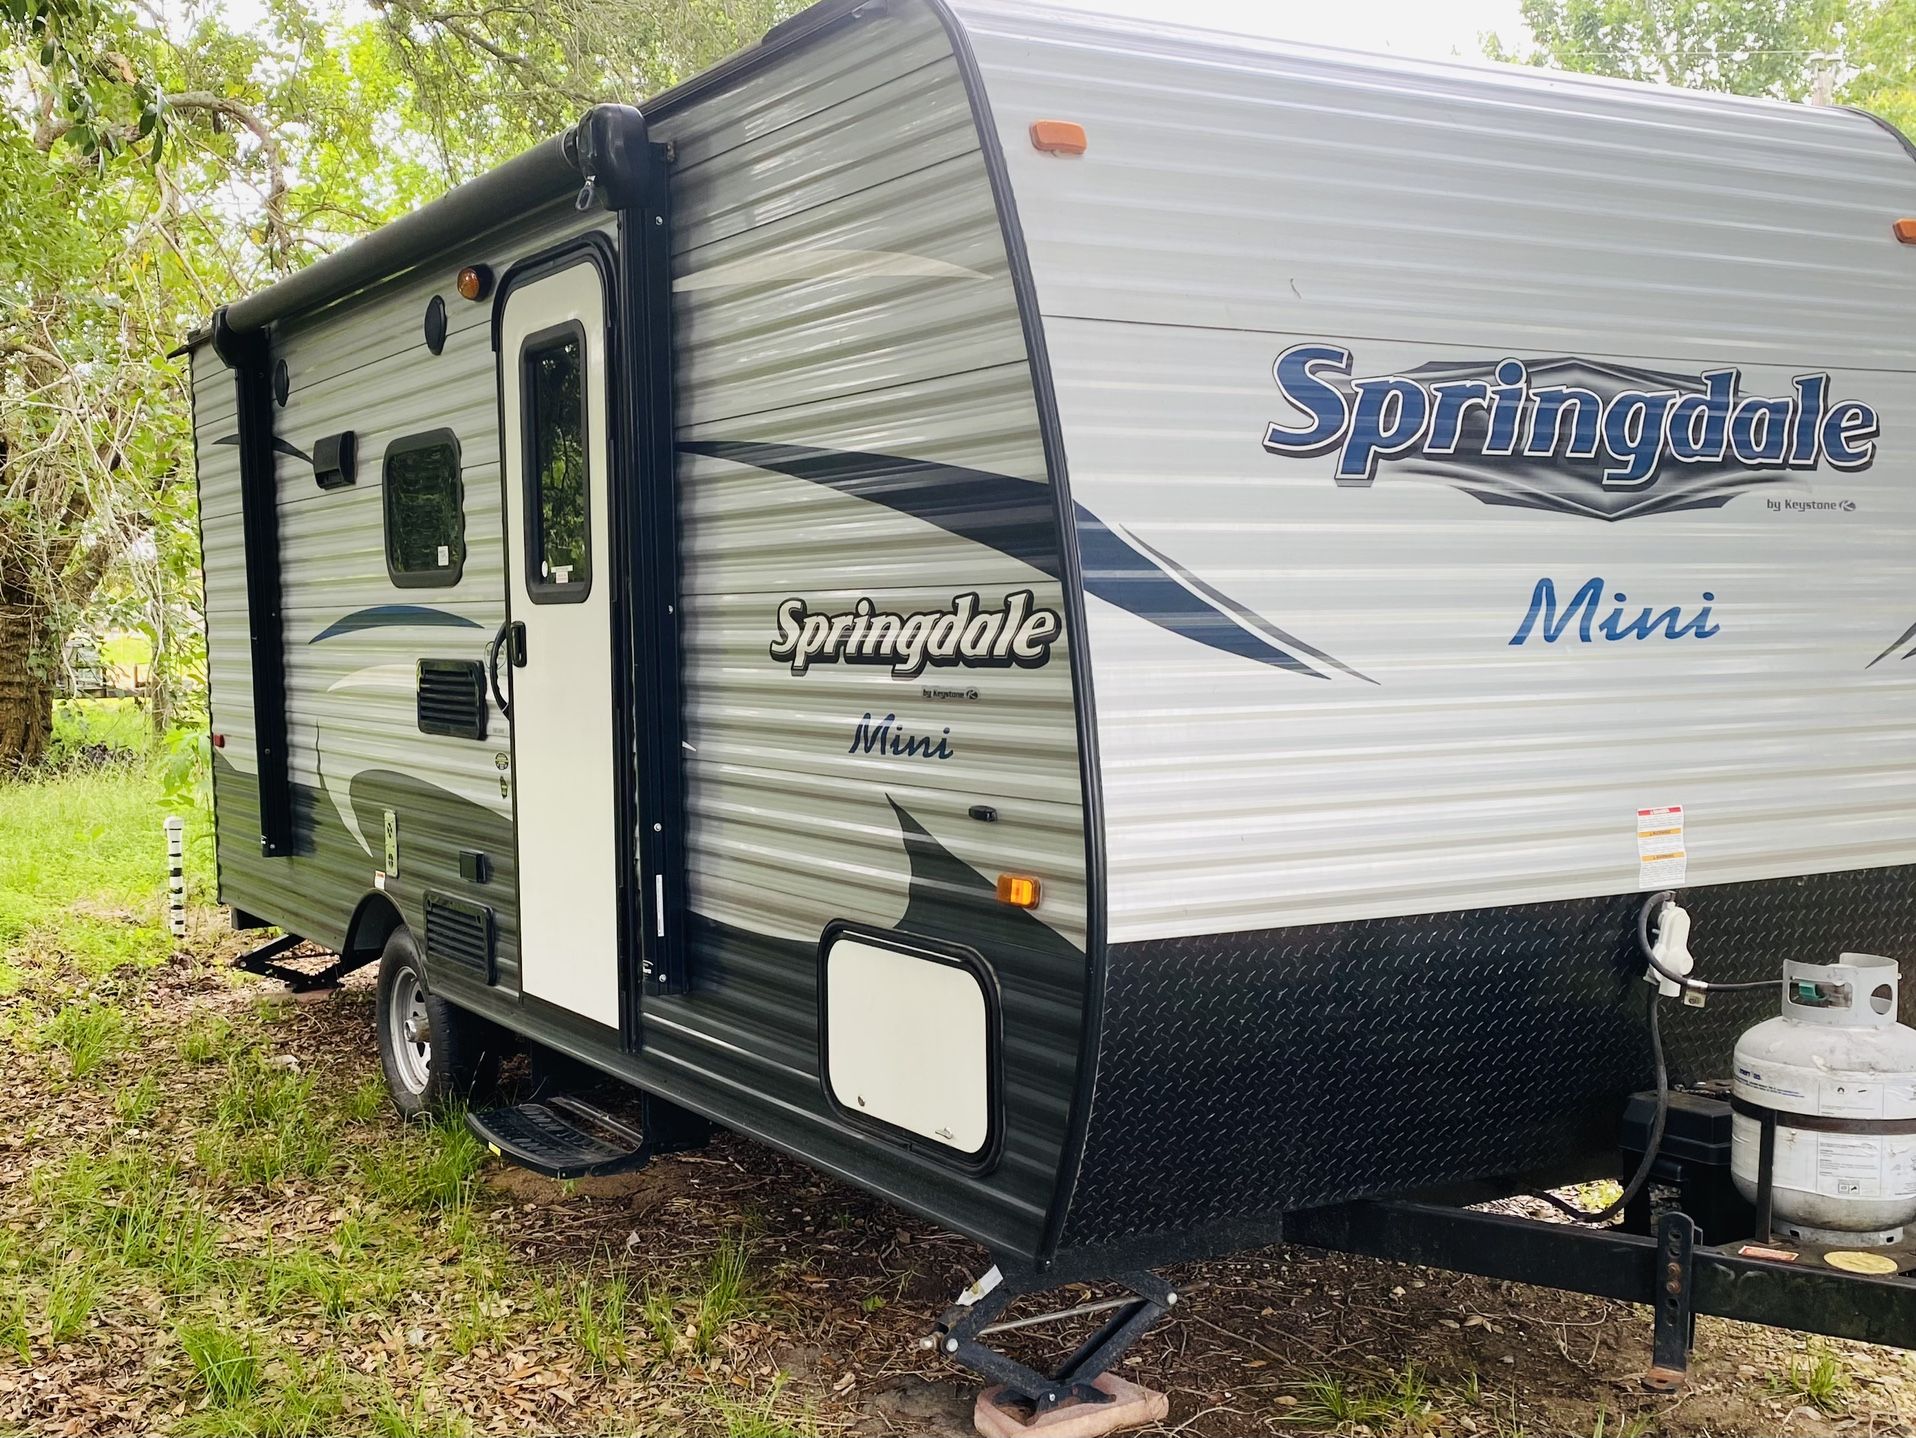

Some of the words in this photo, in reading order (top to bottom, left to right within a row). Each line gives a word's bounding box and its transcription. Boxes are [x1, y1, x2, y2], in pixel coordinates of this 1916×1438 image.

[1263, 343, 1880, 487] Springdale
[1767, 499, 1781, 512] by
[1785, 499, 1837, 512] Keystone
[769, 589, 1062, 681] Springdale
[1508, 577, 1720, 646] Mini
[848, 712, 954, 760] Mini
